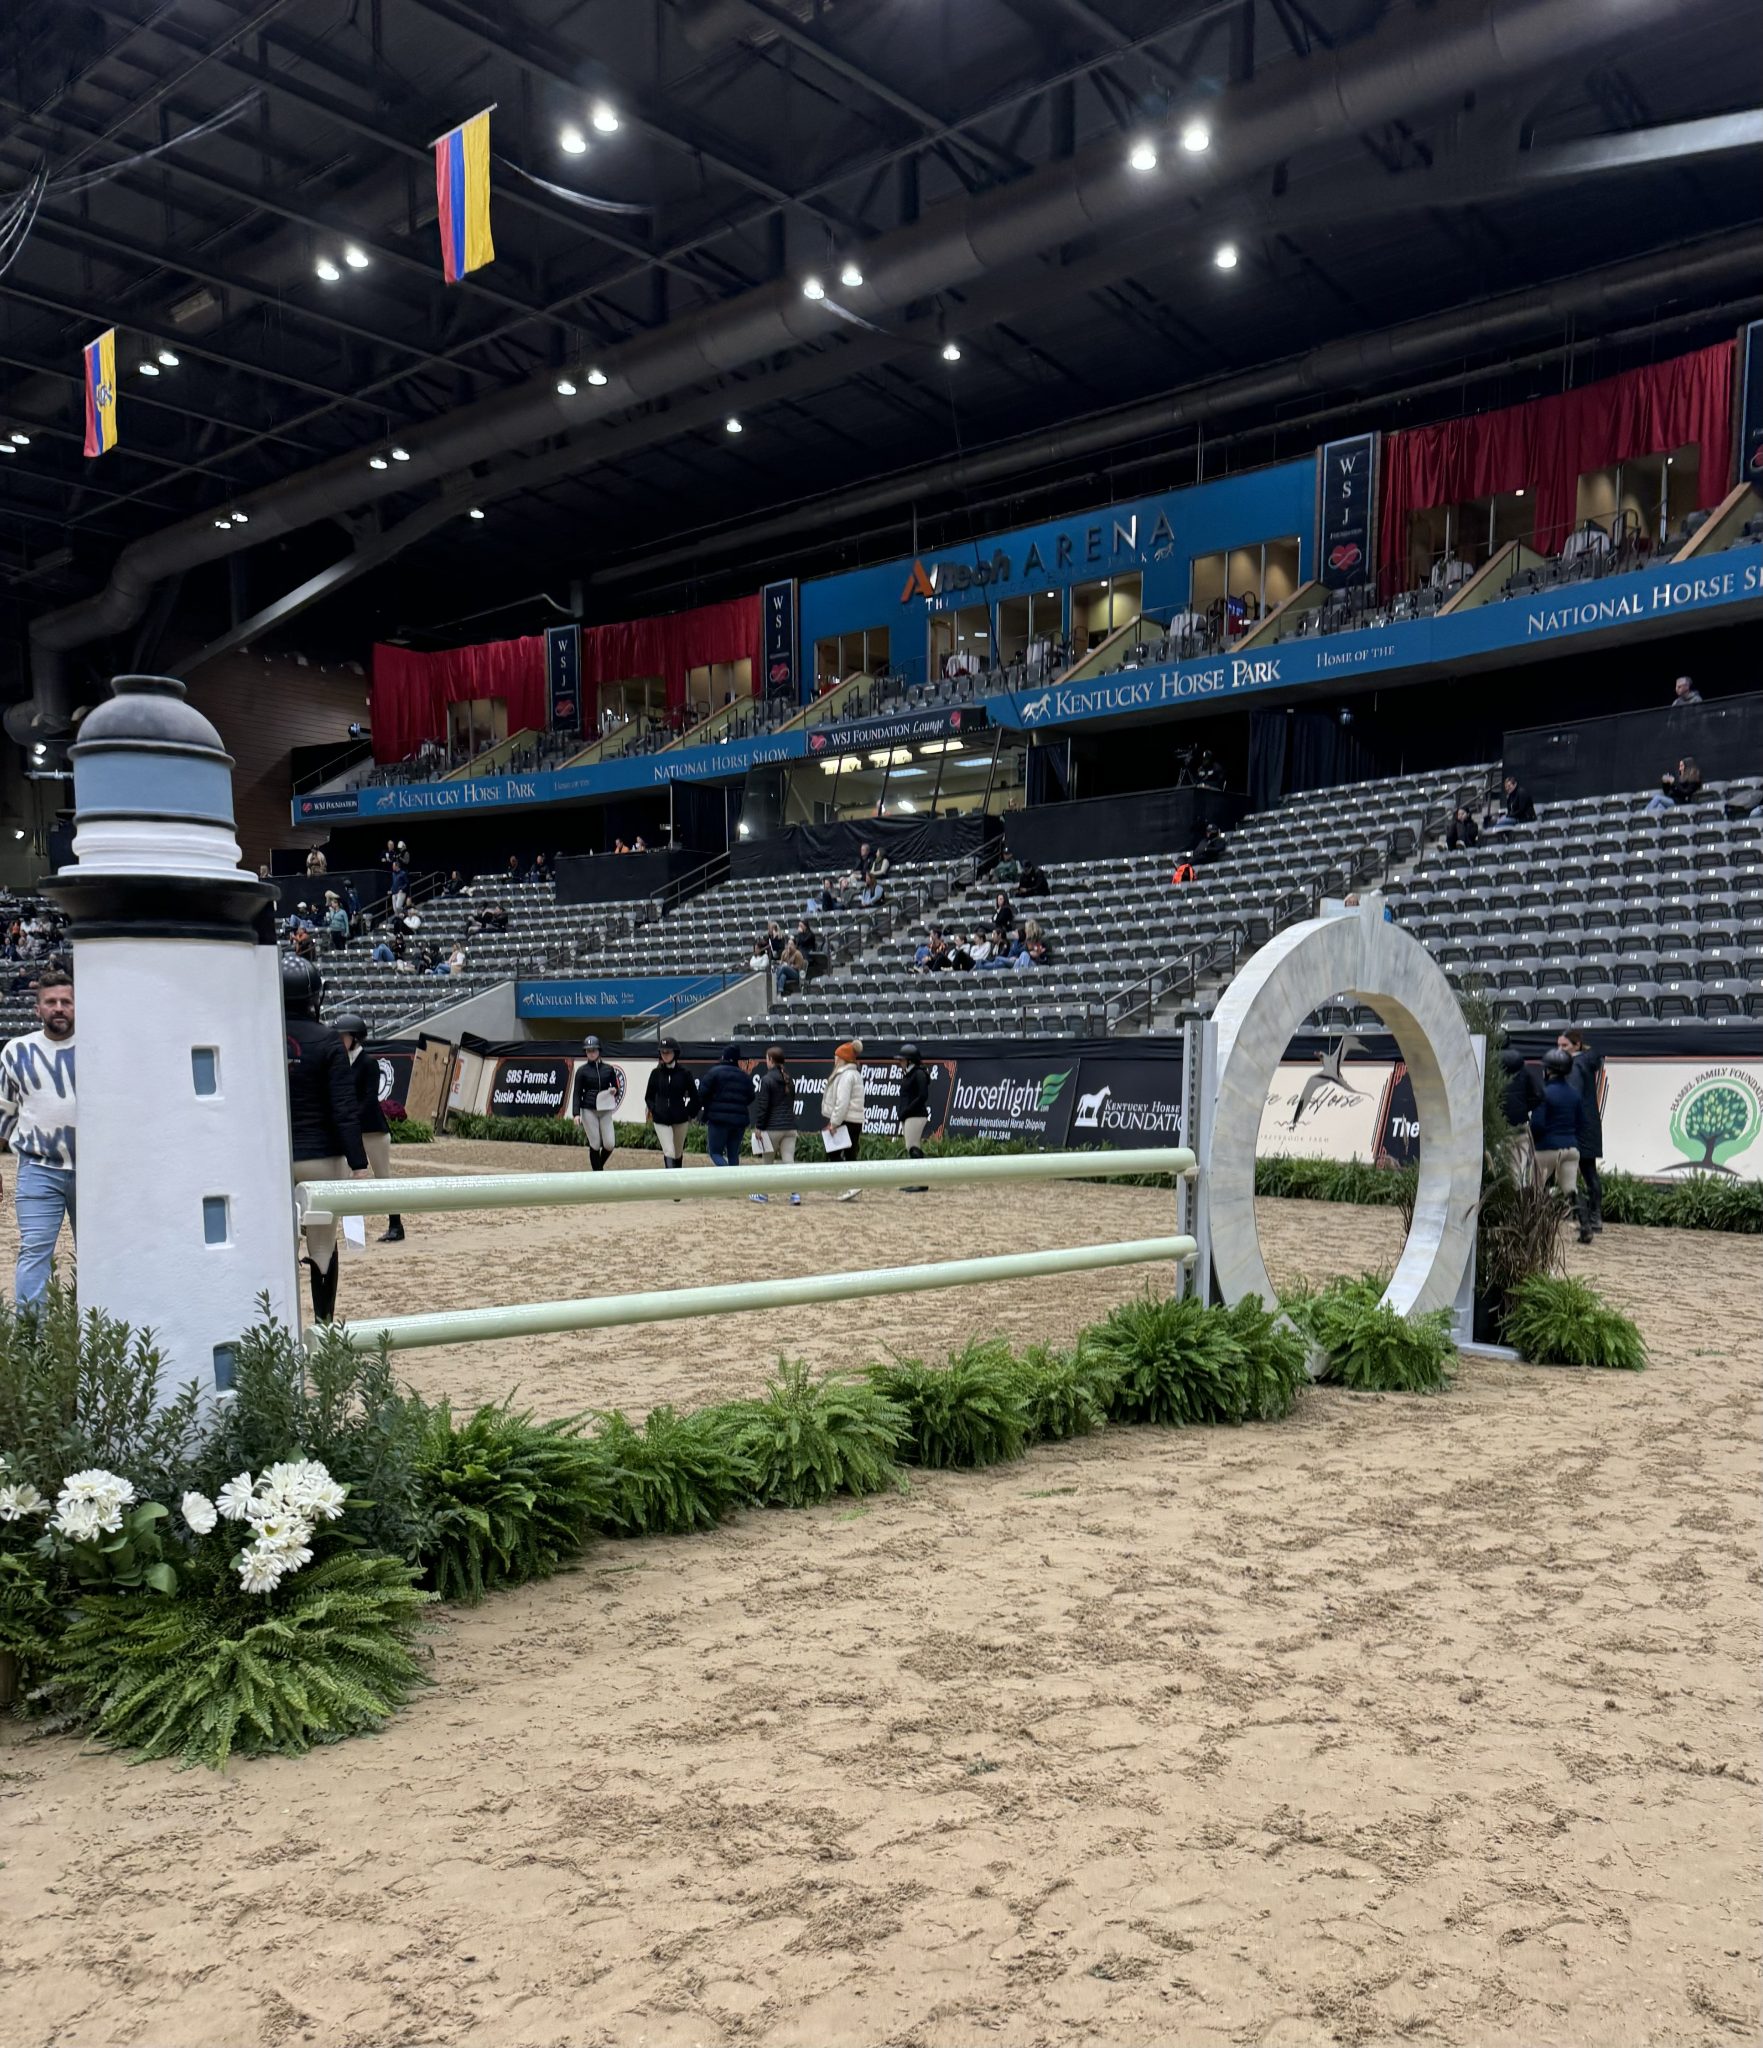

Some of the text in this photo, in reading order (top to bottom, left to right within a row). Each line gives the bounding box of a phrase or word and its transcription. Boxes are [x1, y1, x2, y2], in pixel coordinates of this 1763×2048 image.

[1023, 510, 1175, 578] ARENA
[1527, 593, 1644, 635] NATIONAL
[1652, 573, 1735, 609] HORSE
[1317, 645, 1395, 668] HOME OF THE
[1055, 659, 1281, 716] KENTUCKY HORSE PARK
[831, 719, 944, 746] WSJ FOUNDATION Lounge
[654, 747, 789, 781] NATIONAL HORSE SHOW
[399, 789, 460, 808] KENTUCKY
[463, 783, 501, 803] HORSE
[507, 780, 536, 799] PARK
[535, 991, 572, 1006] KENTUCKY
[575, 991, 597, 1006] HORSE
[600, 991, 618, 1005] PARK
[505, 1069, 557, 1084] SBS Farms &
[860, 1064, 888, 1081] Bryan
[930, 1064, 939, 1080] &
[493, 1088, 564, 1107] Susie Schoellkopf
[953, 1077, 1043, 1117] horseflight
[1670, 1081, 1696, 1112] HAMEL
[1695, 1067, 1728, 1085] FAMILY
[1105, 1099, 1180, 1113] KENTUCKY HORSE
[861, 1119, 897, 1135] Goshen
[949, 1115, 1046, 1132] Excellence in International Horse Shipping
[1100, 1111, 1181, 1131] FOUNDATI
[1392, 1117, 1420, 1138] The
